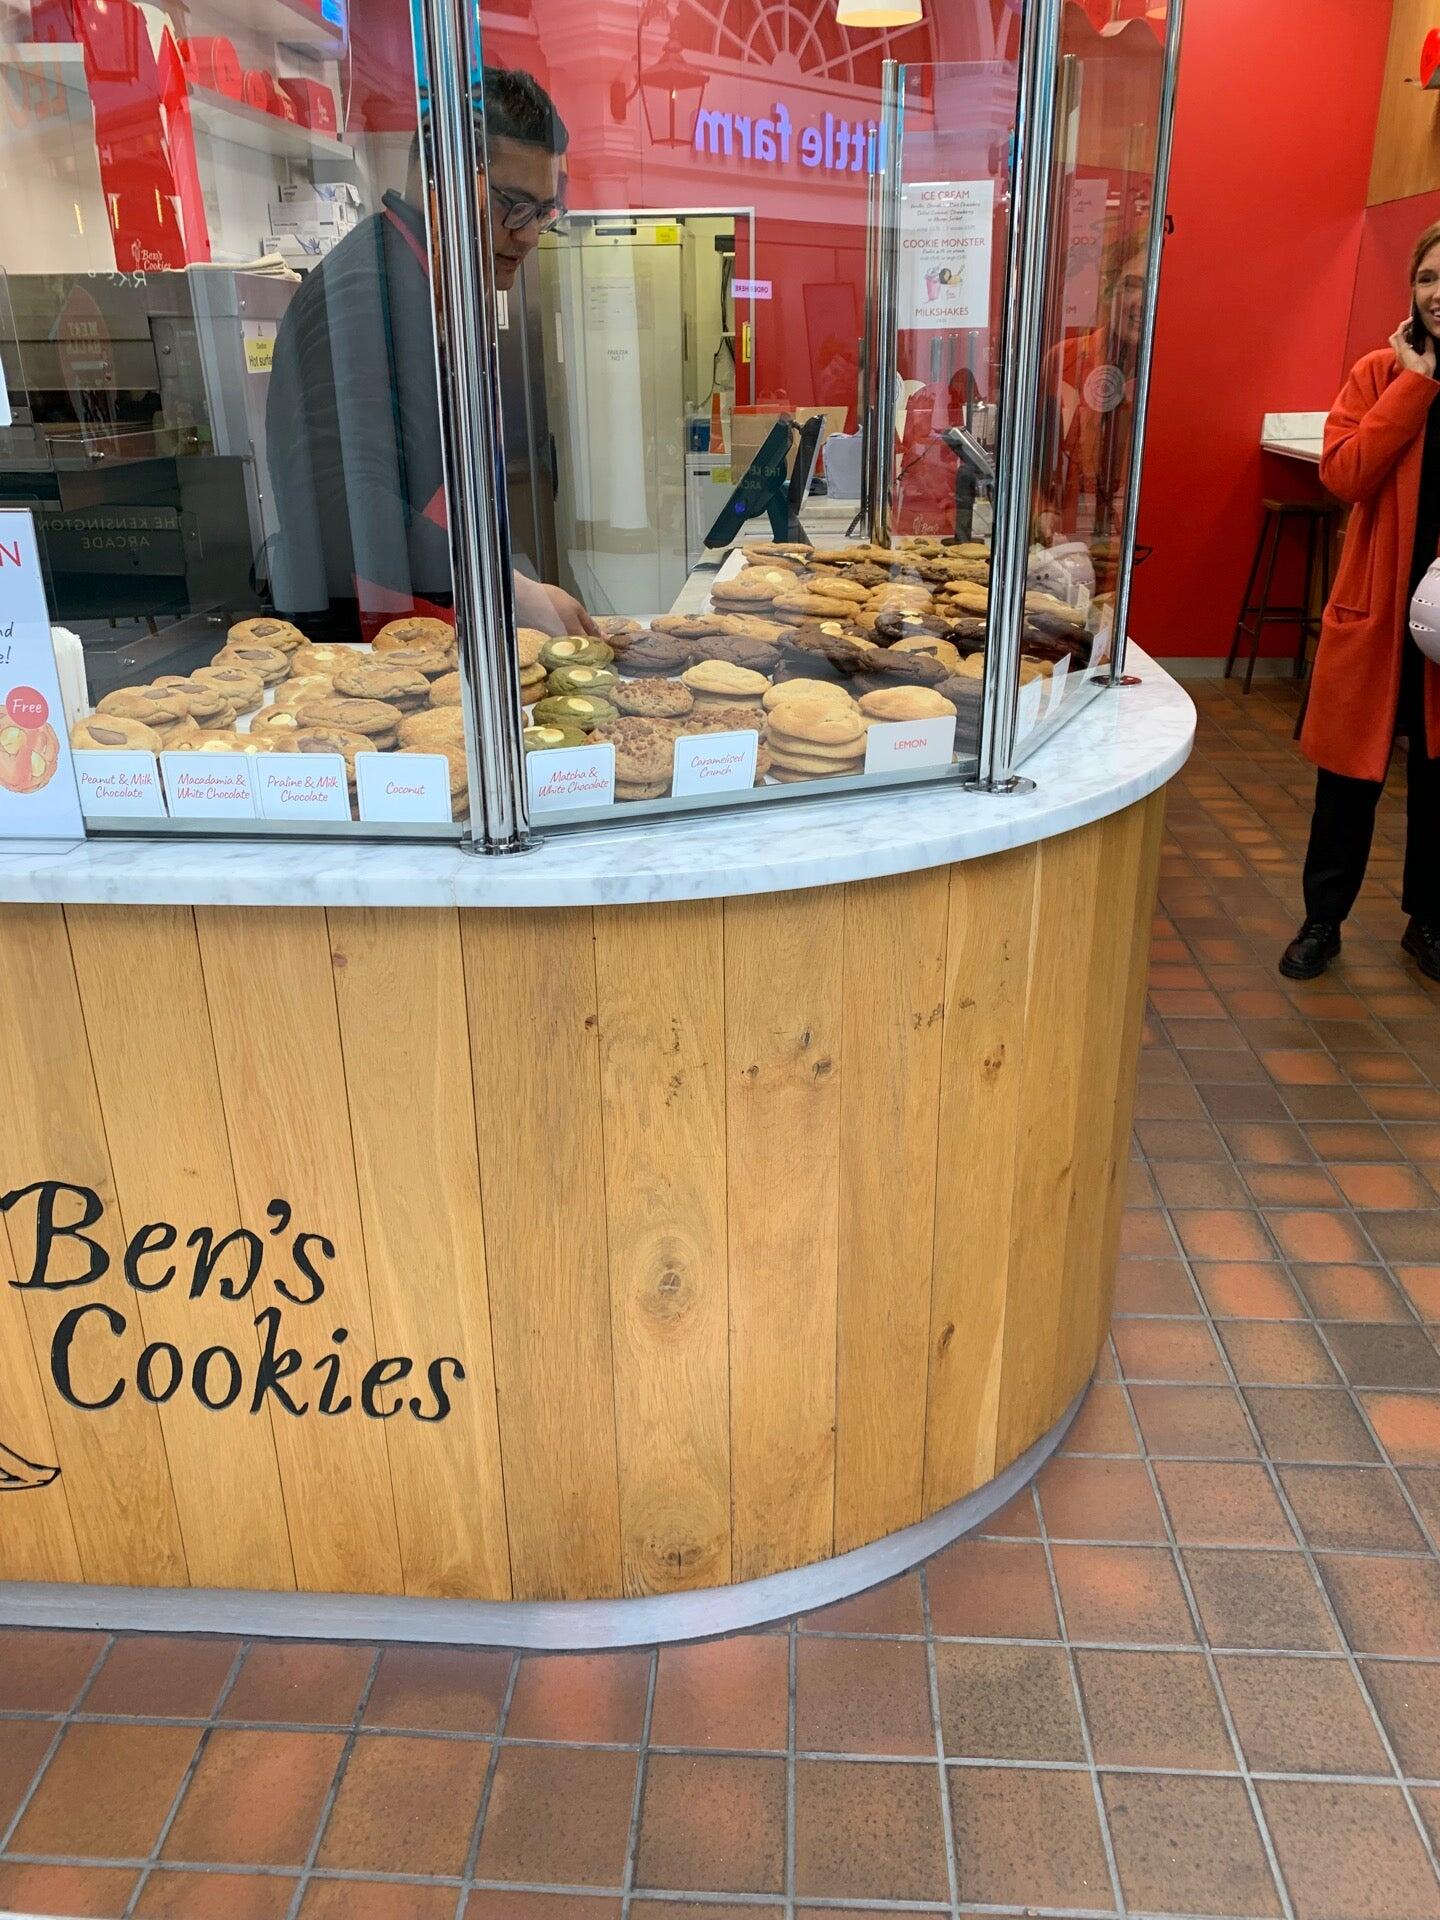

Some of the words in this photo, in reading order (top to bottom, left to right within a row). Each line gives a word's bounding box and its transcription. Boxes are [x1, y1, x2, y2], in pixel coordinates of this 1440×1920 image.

[921, 190, 936, 201] ICE
[938, 189, 970, 200] CREAM
[902, 238, 940, 249] COOKIE
[941, 237, 985, 248] MONSTER
[141, 249, 163, 260] Ben's
[915, 307, 969, 317] MILKSHAKES
[259, 354, 272, 367] surfa
[0, 541, 21, 567] N
[12, 698, 42, 714] Free
[894, 738, 927, 750] LEMON
[690, 752, 746, 769] Caramelised
[81, 773, 116, 785] Peanut
[118, 773, 129, 786] &
[130, 773, 153, 785] Milk
[550, 769, 586, 783] Matcha
[589, 766, 598, 778] &
[699, 767, 732, 779] Crunch
[178, 773, 234, 786] Macadamia
[235, 774, 247, 787] &
[267, 775, 303, 788] Praline
[304, 776, 315, 788] &
[317, 776, 338, 788] Milk
[95, 786, 144, 799] Chocolate
[177, 787, 205, 799] White
[206, 787, 250, 800] Chocolate
[385, 781, 425, 795] Coconut
[538, 784, 565, 797] White
[567, 779, 609, 794] Chocolate
[280, 789, 329, 803] Chocolate
[0, 1180, 335, 1304] Ben's
[51, 1303, 465, 1421] Cookies
